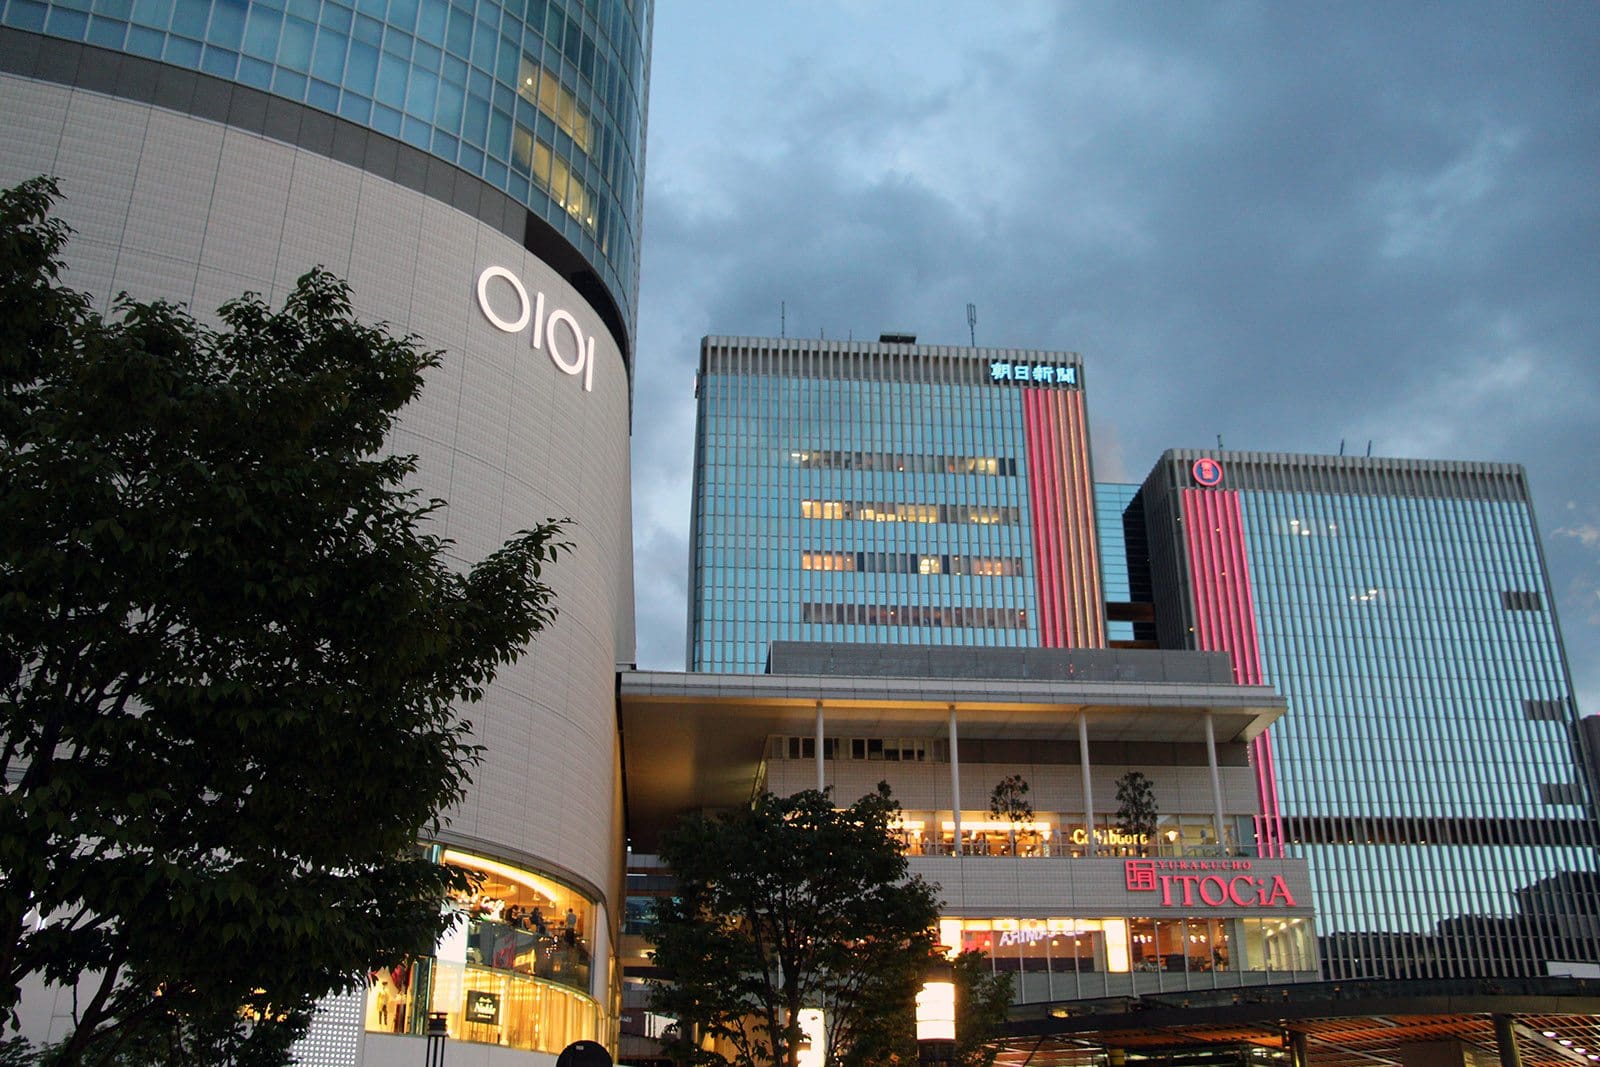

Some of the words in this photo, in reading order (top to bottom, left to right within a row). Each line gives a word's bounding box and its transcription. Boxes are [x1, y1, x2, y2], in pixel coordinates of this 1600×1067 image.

[990, 362, 1076, 384] 朝日新聞
[1158, 860, 1251, 870] YURAKUCHO
